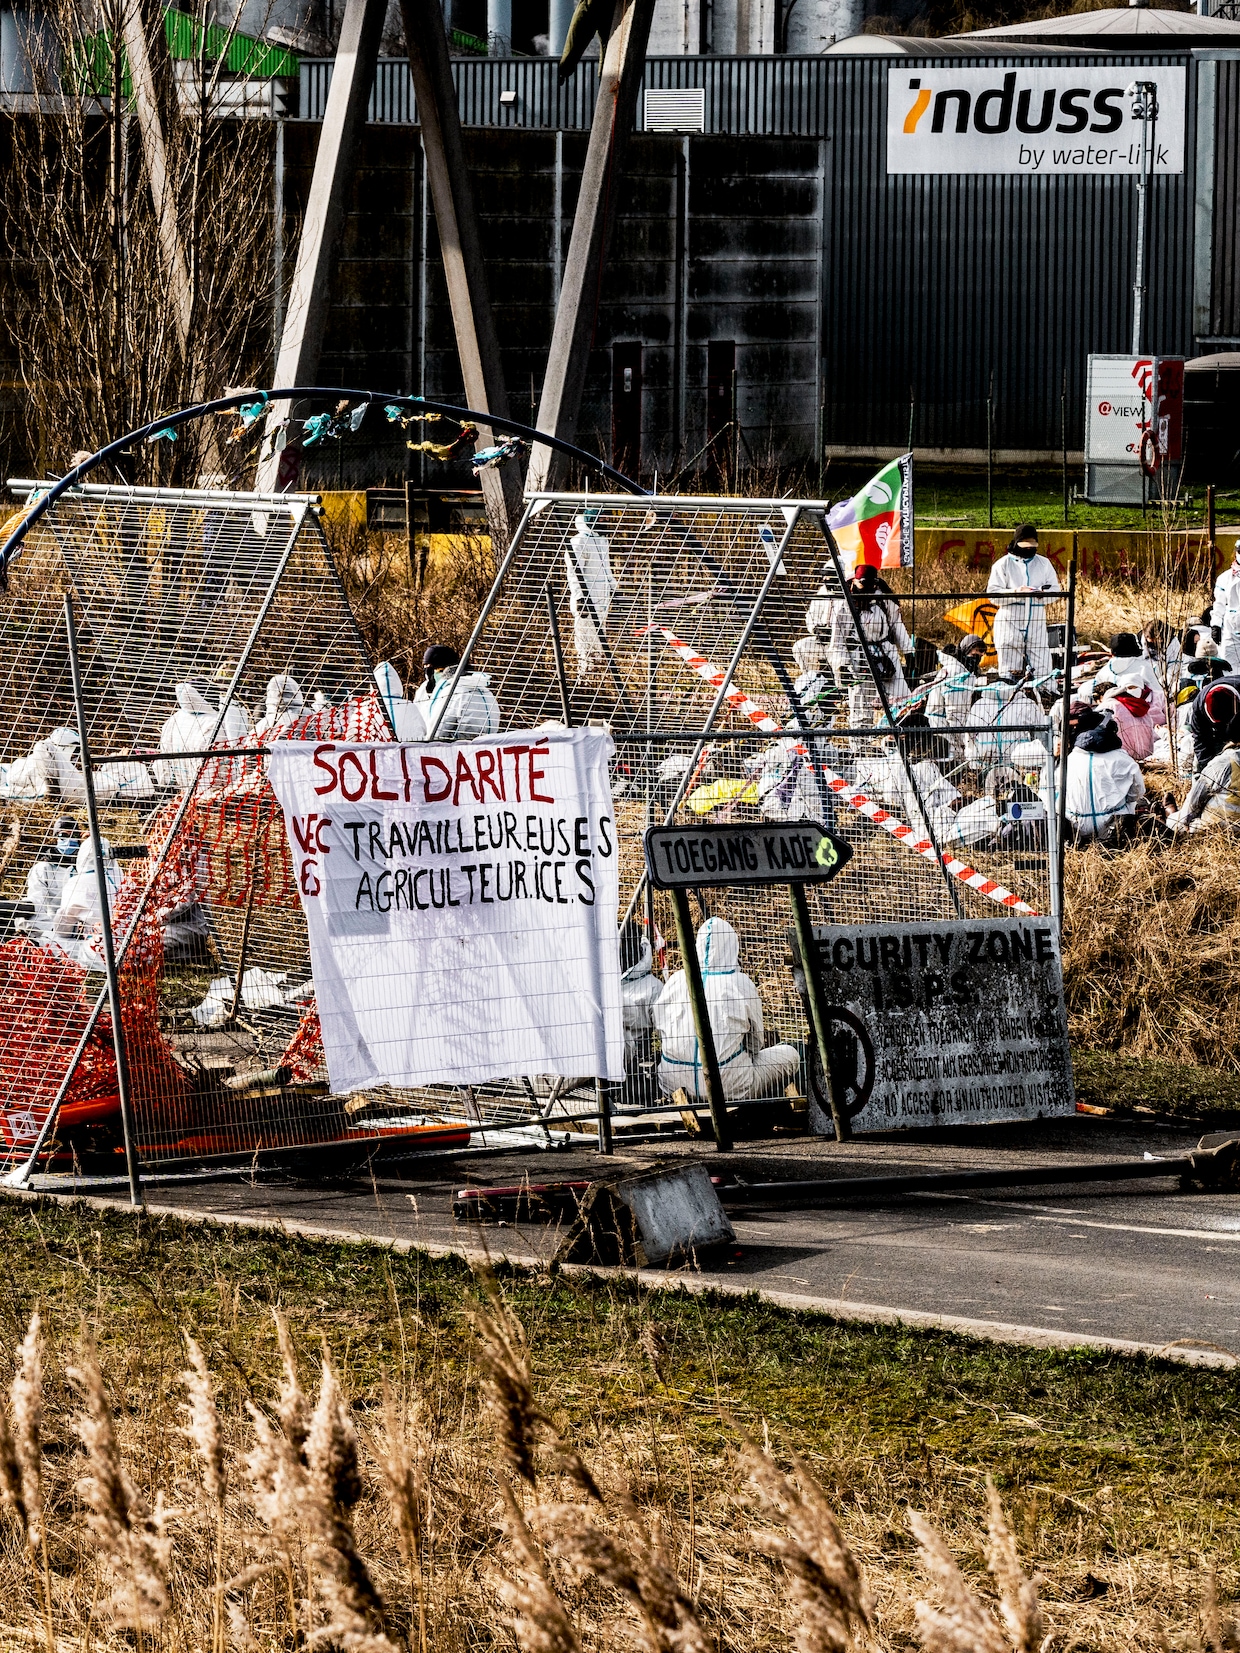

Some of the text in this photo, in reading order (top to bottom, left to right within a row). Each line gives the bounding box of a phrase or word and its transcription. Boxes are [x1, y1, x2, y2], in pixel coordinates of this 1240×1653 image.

[903, 71, 1125, 134] induss
[1018, 144, 1045, 170] by
[313, 736, 555, 807] SOLIDARITÉ
[660, 834, 820, 874] TOEGANG KADE
[812, 928, 1055, 973] ECURITY ZONE
[942, 1054, 958, 1078] AUX
[1021, 1046, 1067, 1073] AUTORI
[884, 1092, 898, 1117] NO
[901, 1090, 930, 1115] ACCES
[954, 1083, 1026, 1112] UNAUTHORIZED
